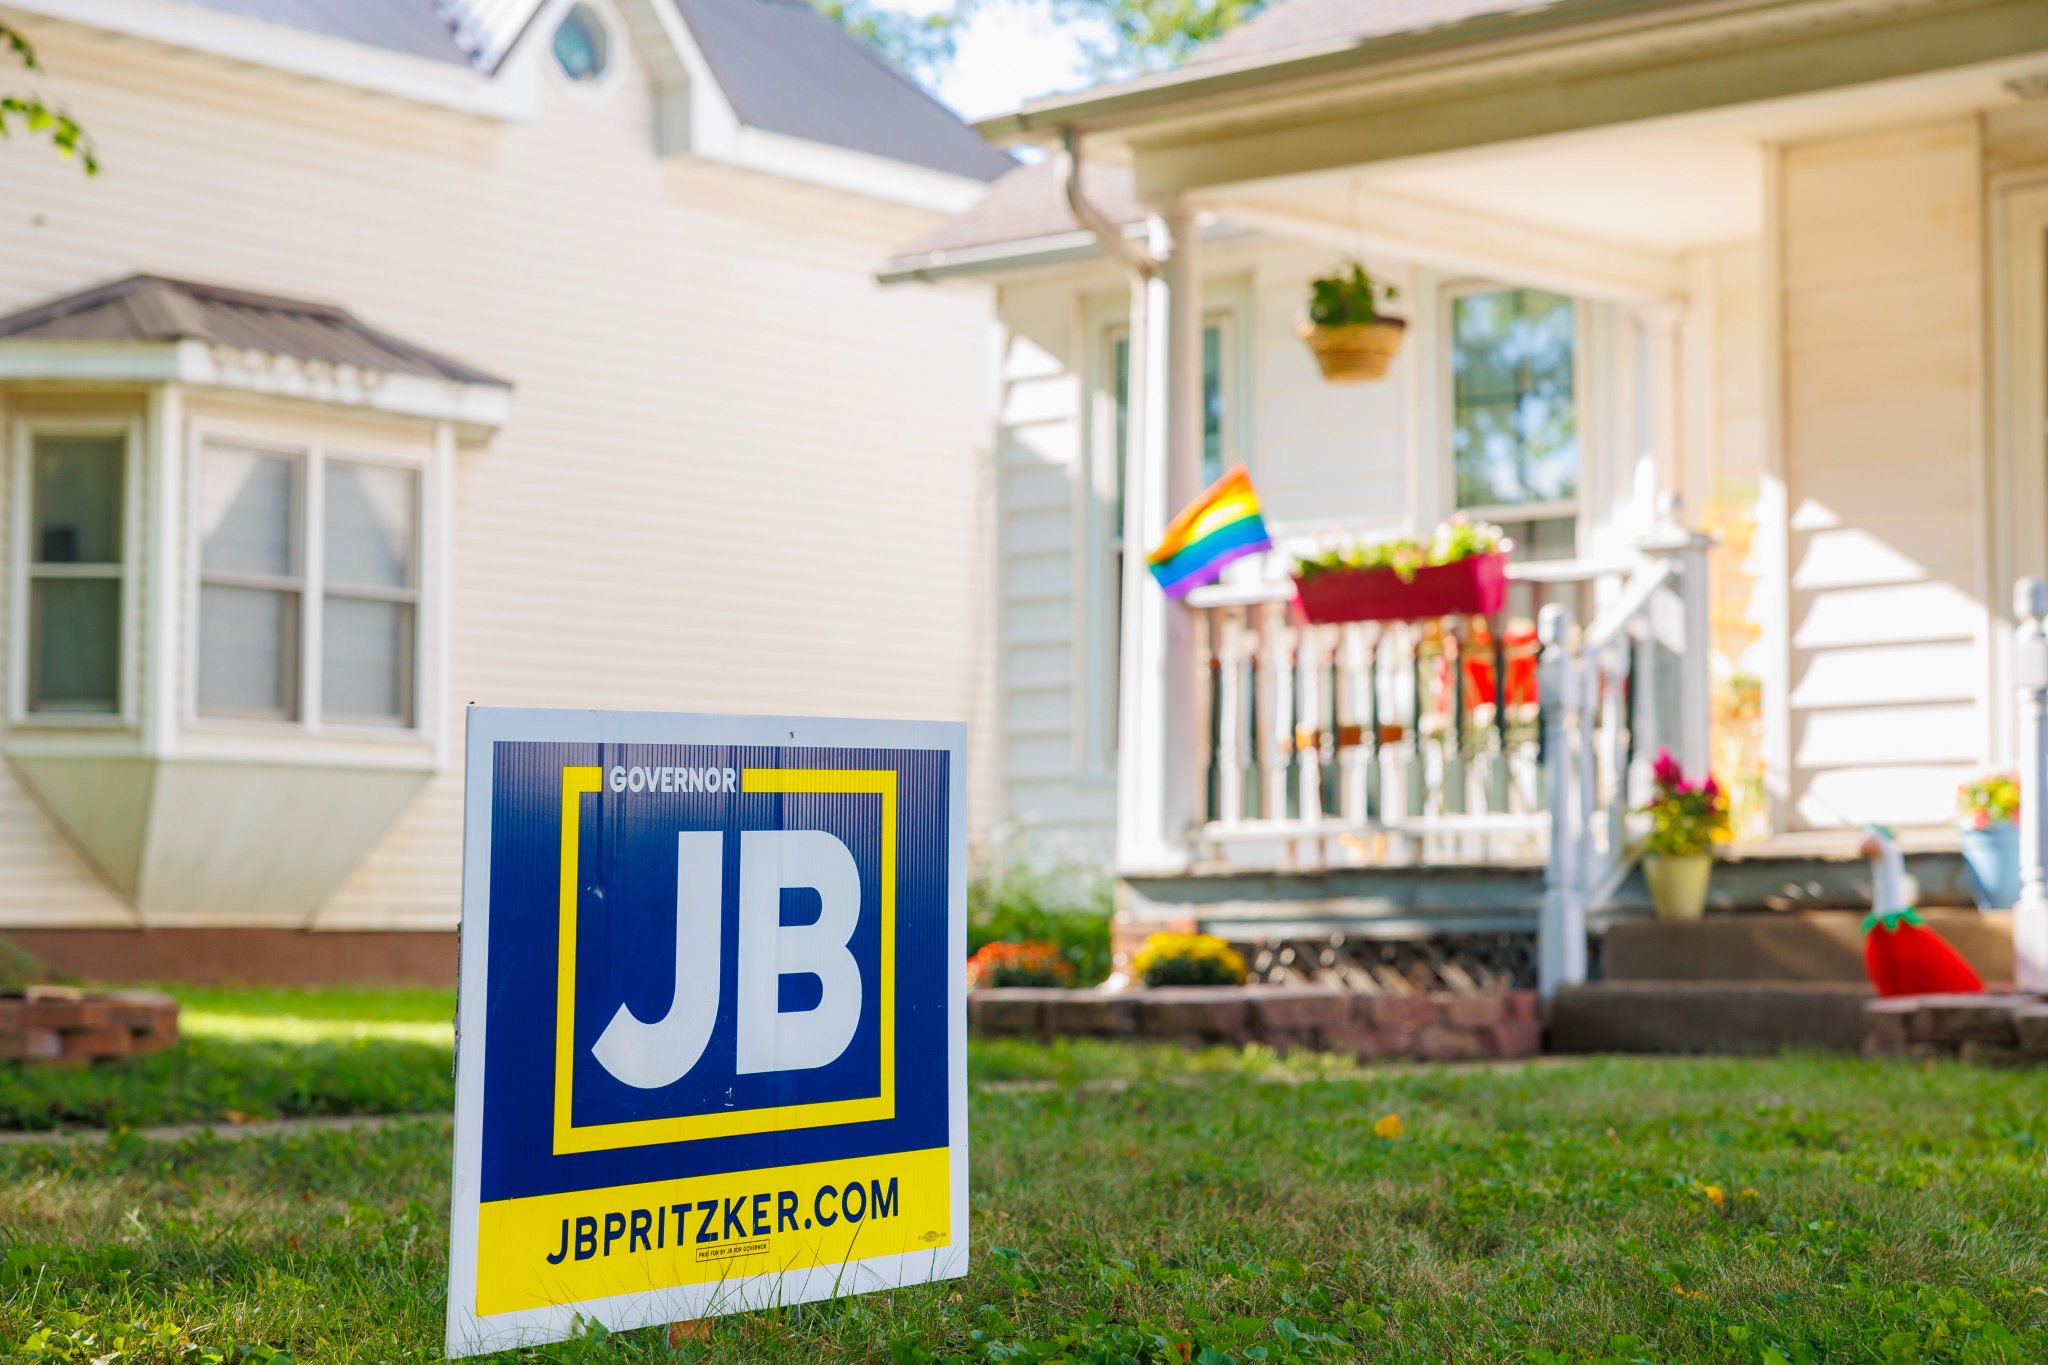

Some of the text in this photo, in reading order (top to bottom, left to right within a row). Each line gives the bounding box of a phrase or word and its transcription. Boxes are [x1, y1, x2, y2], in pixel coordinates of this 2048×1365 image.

[609, 765, 736, 793] GOVERNOR
[591, 830, 862, 1089] JB
[546, 1177, 899, 1265] JBPRITZKER.COM
[720, 1248, 727, 1256] BY
[743, 1243, 767, 1252] GOVERNOR
